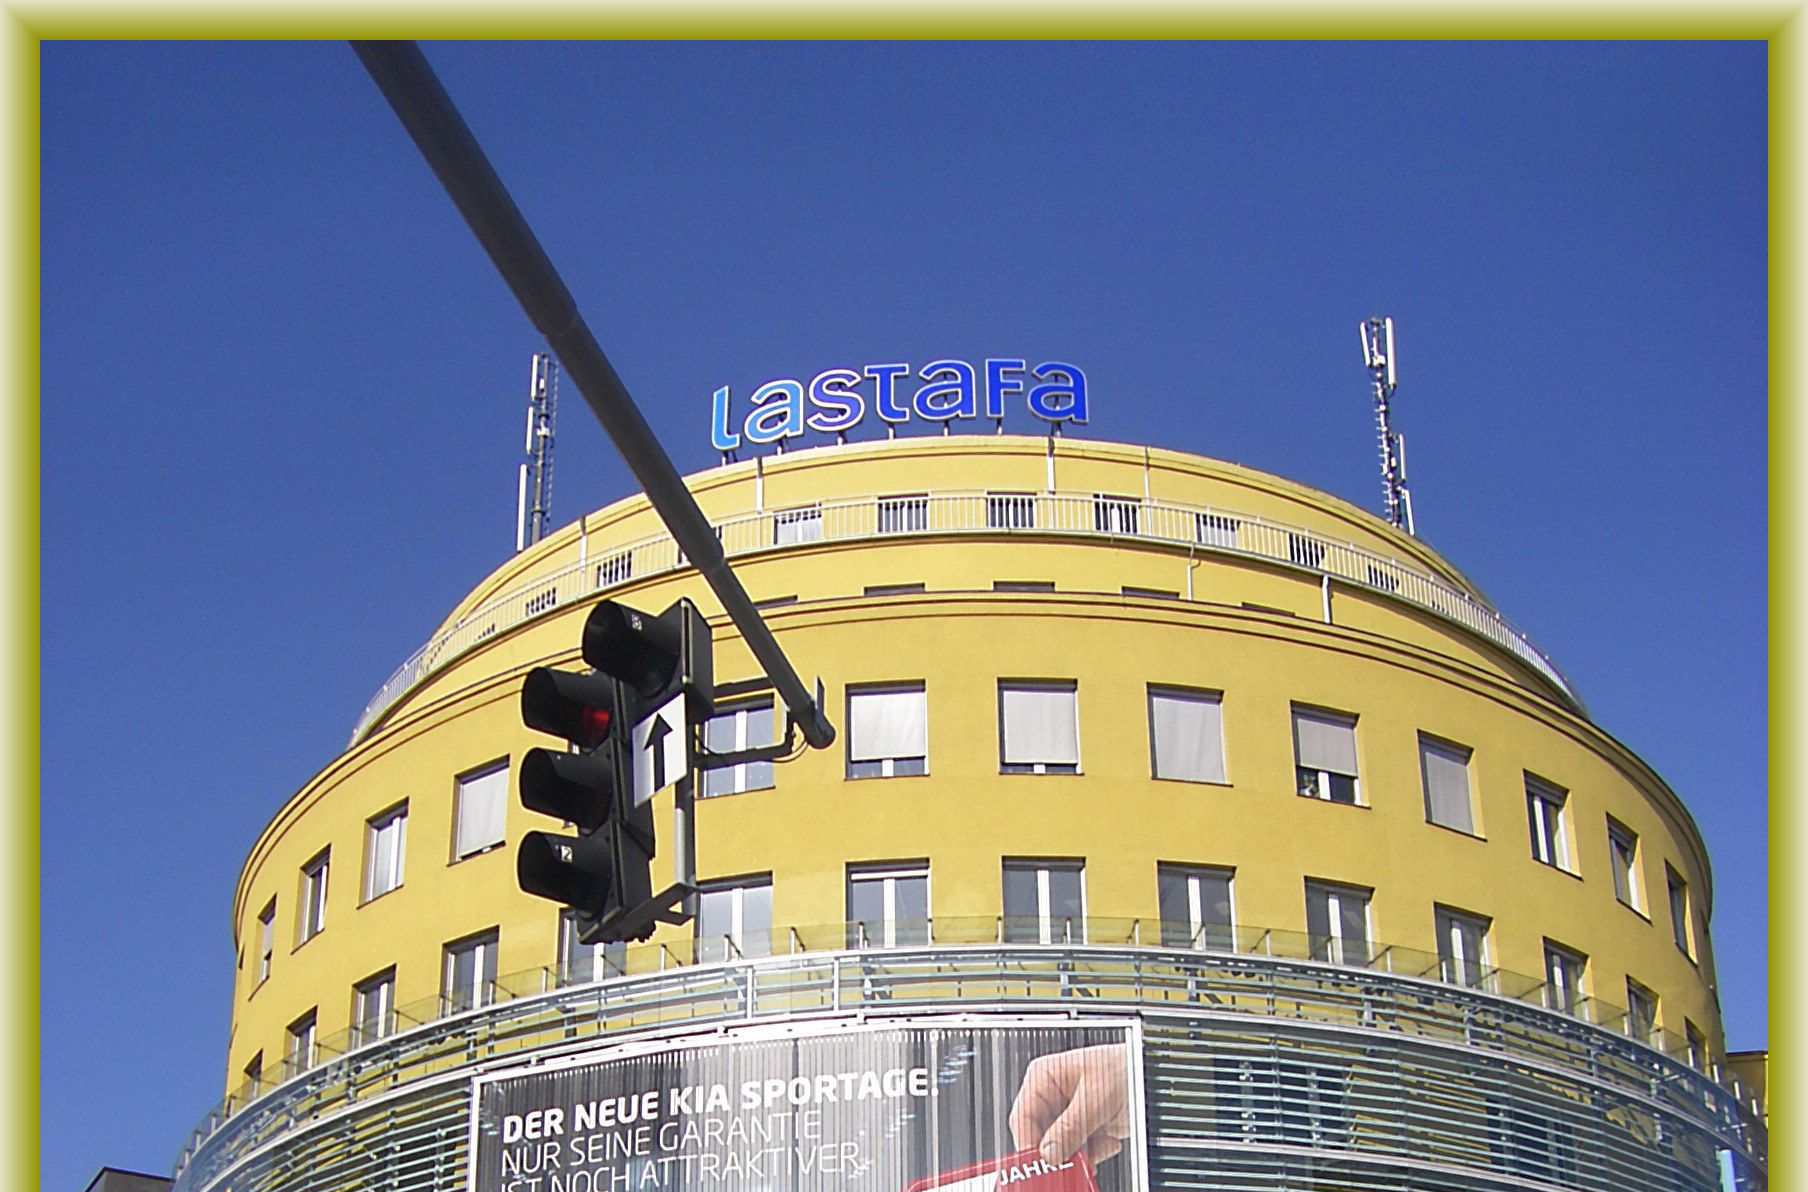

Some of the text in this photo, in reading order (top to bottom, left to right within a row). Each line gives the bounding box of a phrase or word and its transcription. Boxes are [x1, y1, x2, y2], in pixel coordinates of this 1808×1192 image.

[503, 1067, 939, 1144] DER NEUE KIA SPORTAGE.
[501, 1109, 821, 1177] NUR SEINE GARANTIE
